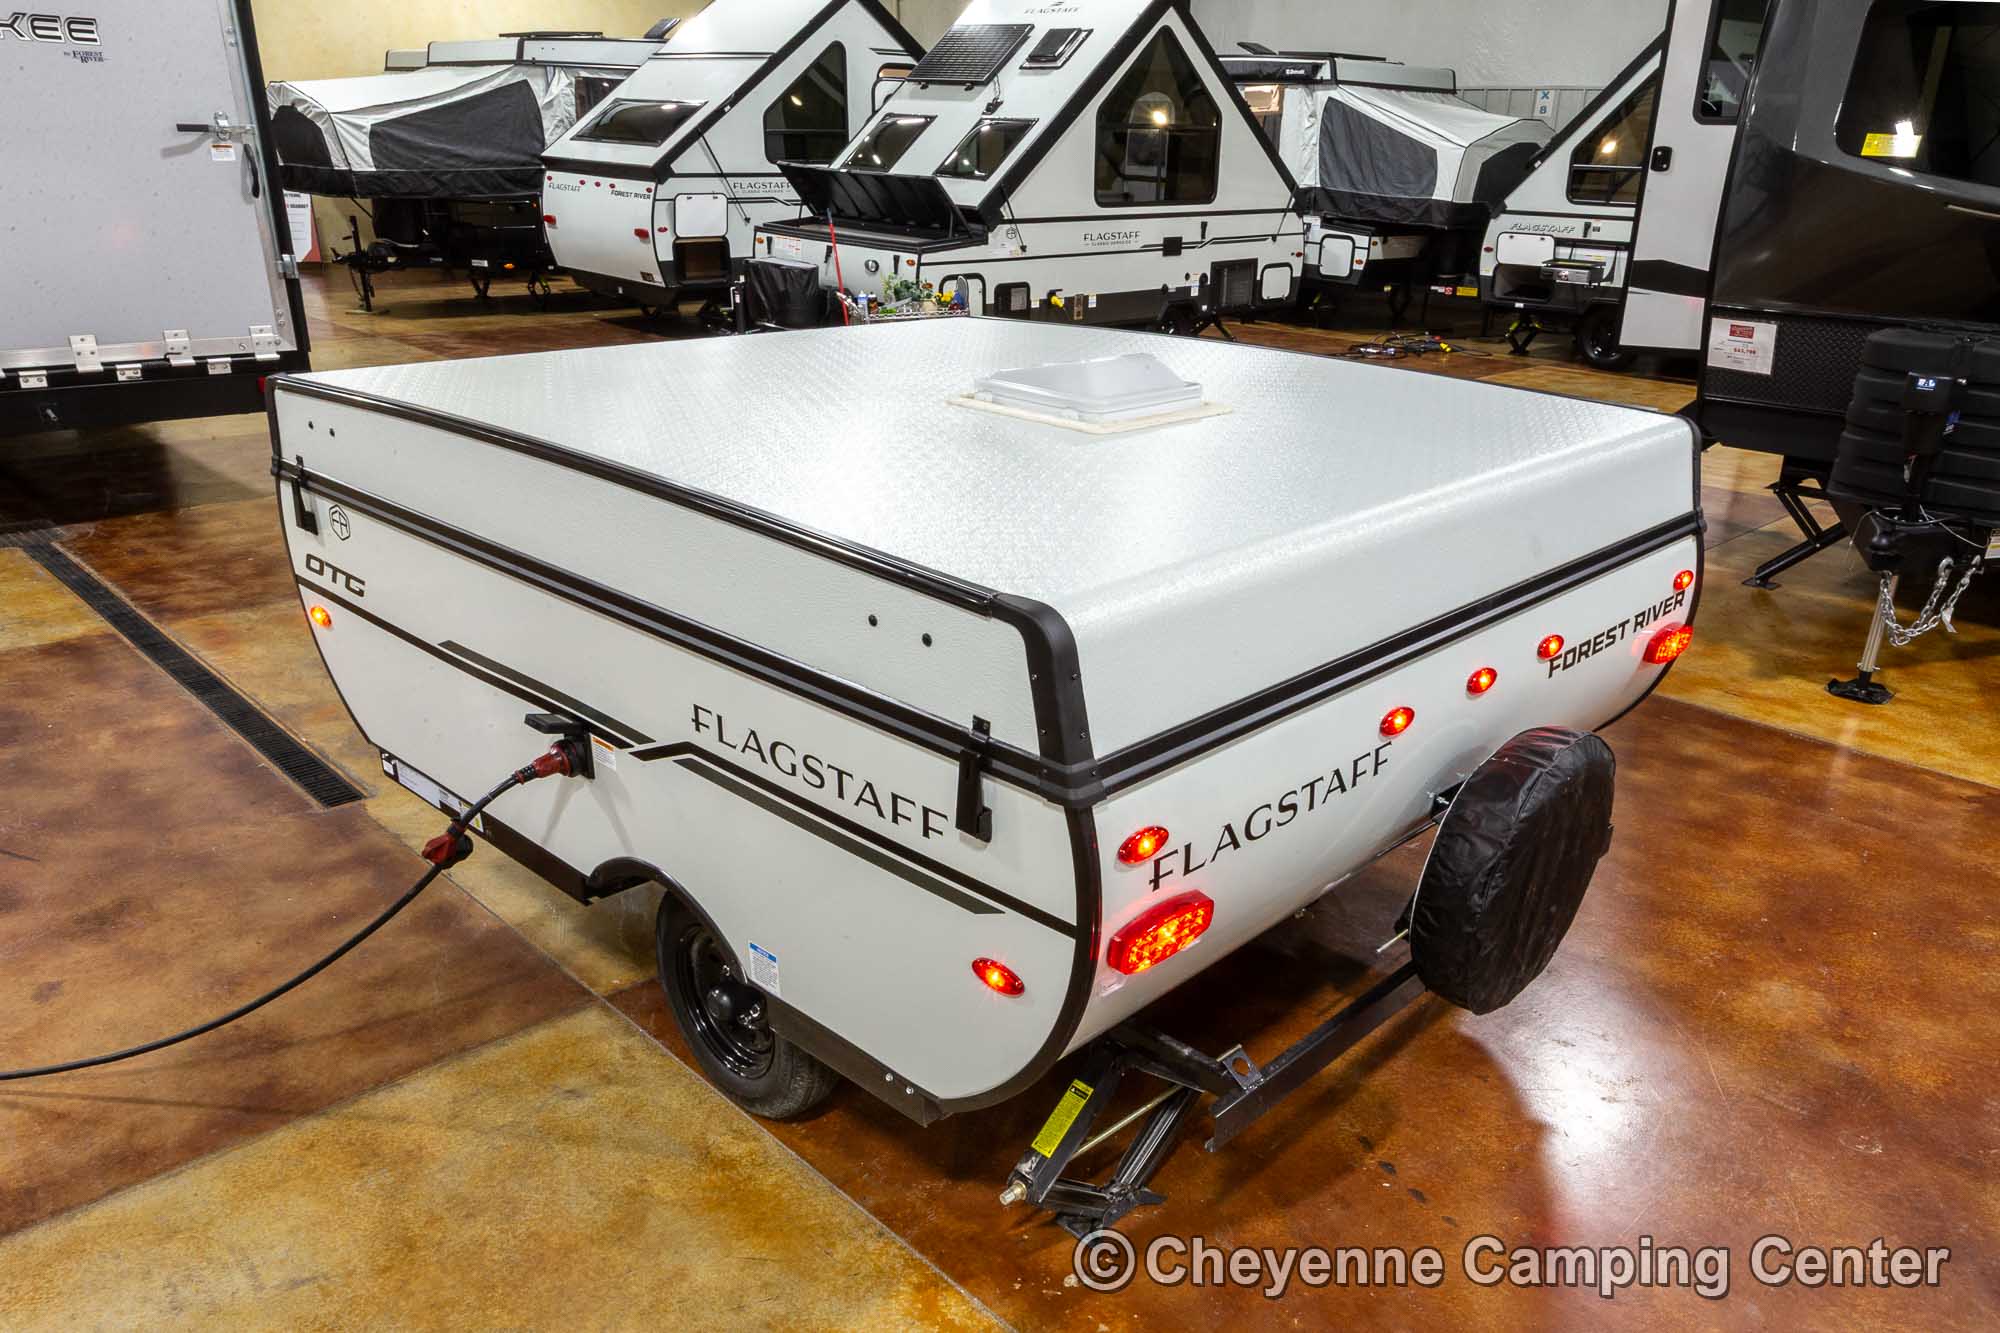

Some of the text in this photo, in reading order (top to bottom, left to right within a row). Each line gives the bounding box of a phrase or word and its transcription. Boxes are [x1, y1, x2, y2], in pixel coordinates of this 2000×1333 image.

[548, 182, 581, 193] FLAGSTAFF
[611, 190, 651, 200] FOREST RIVER
[1083, 231, 1141, 241] FLAGSTAFF
[1509, 223, 1576, 234] FLAGSTAFF
[306, 553, 366, 597] OTG
[1548, 589, 1686, 679] FOREST RIVER
[691, 703, 949, 839] FLAGSTAFF
[1148, 741, 1392, 892] FLAGSTAFF
